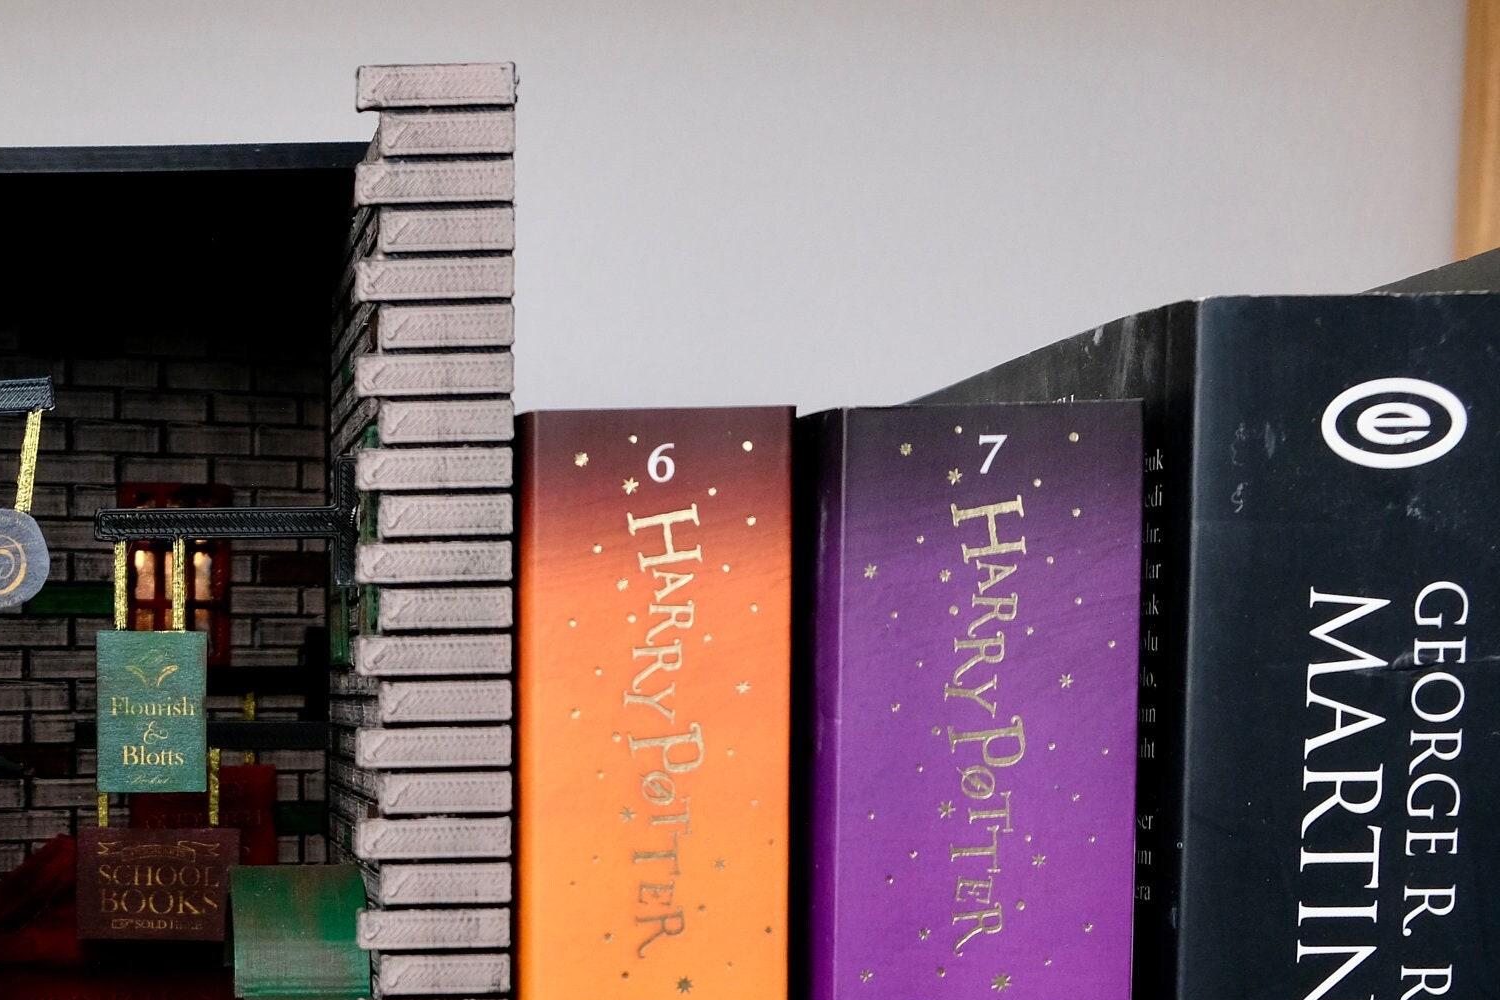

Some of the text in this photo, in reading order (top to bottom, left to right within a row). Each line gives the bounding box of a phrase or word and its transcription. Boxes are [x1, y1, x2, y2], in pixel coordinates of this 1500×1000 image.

[647, 442, 676, 484] 6
[977, 434, 1008, 475] 7
[623, 503, 703, 724] HARRY
[944, 494, 1026, 718] HARRY
[110, 696, 195, 716] Flourish
[1405, 580, 1469, 856] GEORGE
[138, 720, 169, 744] &
[123, 745, 184, 766] Blotts
[98, 864, 220, 887] SCHOOL
[100, 889, 218, 915] BOOKS
[1402, 884, 1456, 937] R.
[135, 919, 167, 930] SOLD
